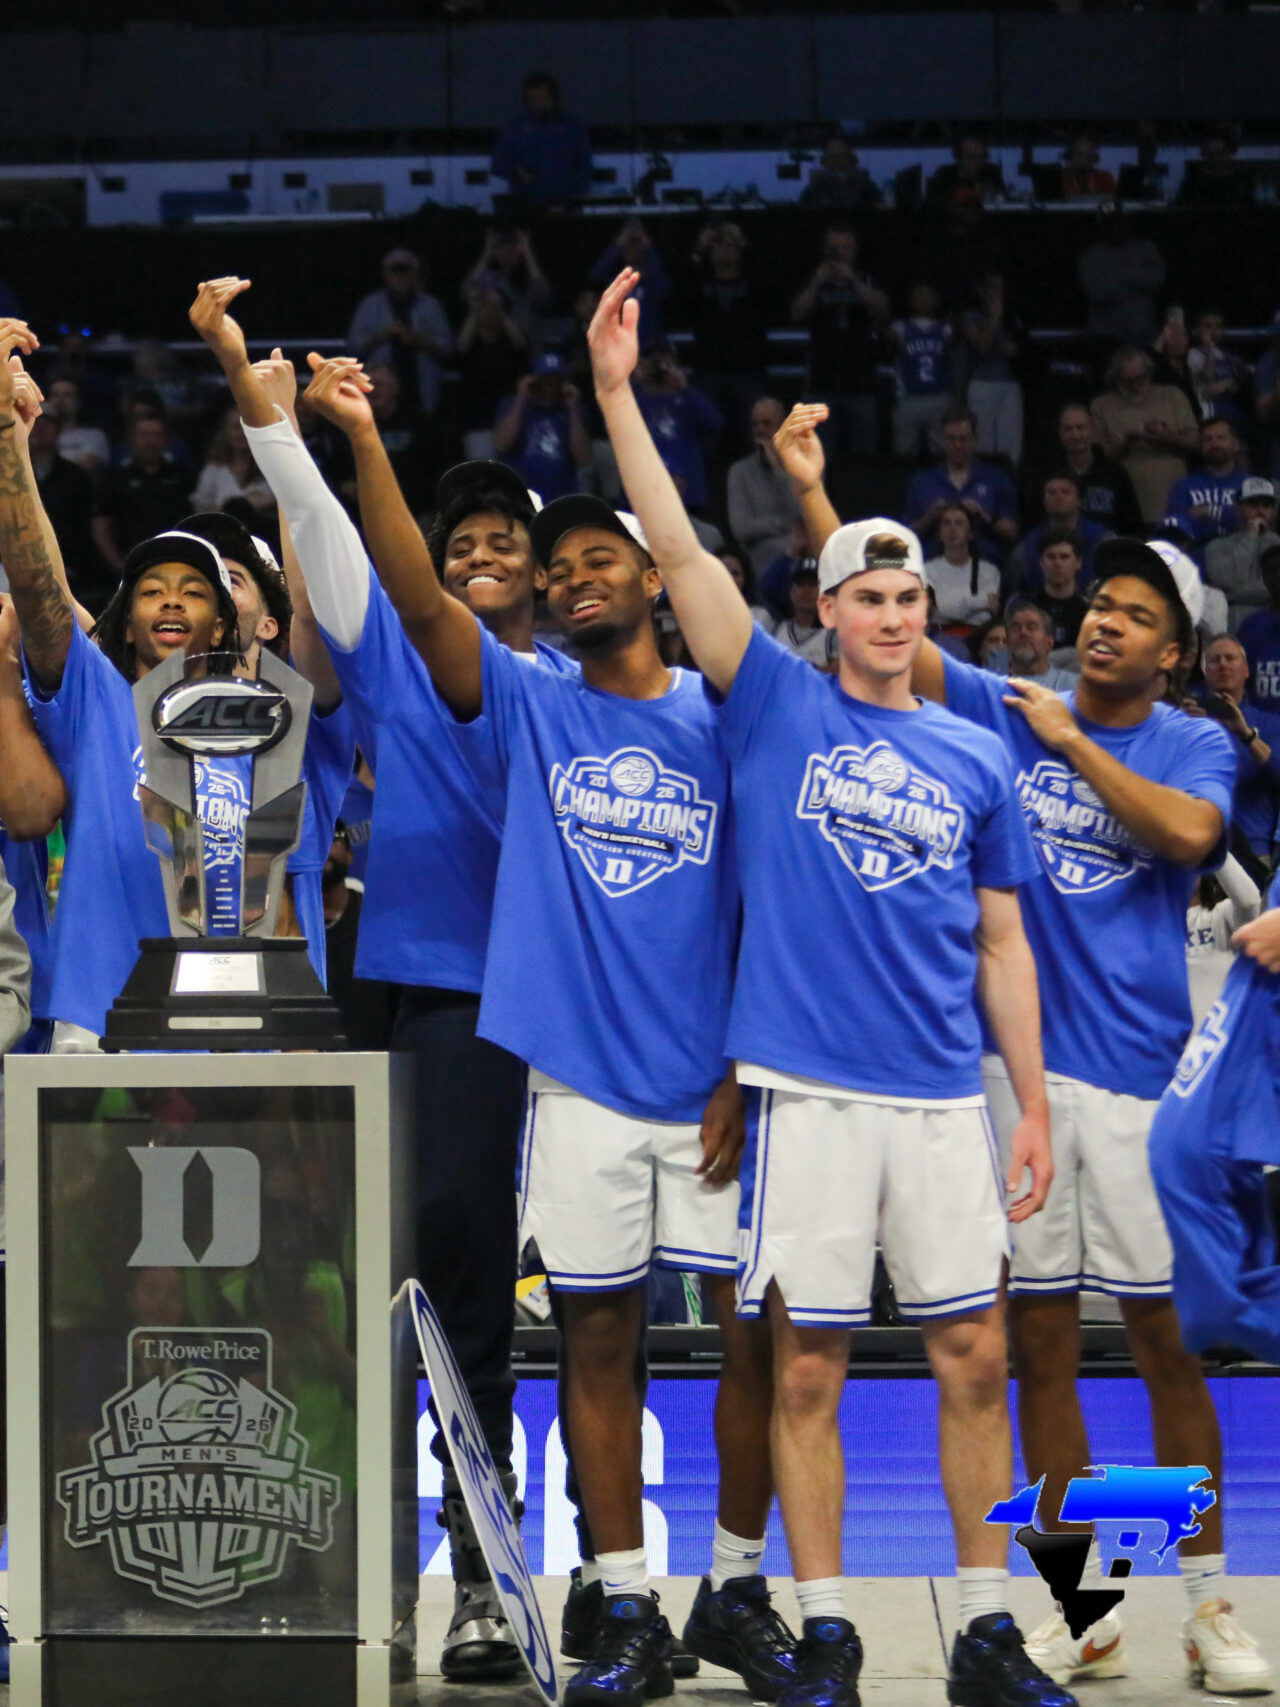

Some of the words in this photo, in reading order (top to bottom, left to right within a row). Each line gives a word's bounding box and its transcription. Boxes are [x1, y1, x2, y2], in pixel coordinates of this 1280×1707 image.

[1189, 489, 1236, 505] DUK
[174, 696, 279, 728] ACC
[589, 774, 608, 788] 20
[1049, 780, 1069, 795] 20
[655, 786, 676, 799] 26
[554, 776, 708, 851] CHAMPIONS
[807, 766, 958, 856] CHAMPIONS
[126, 1146, 260, 1267] D
[167, 1400, 239, 1418] ACC
[129, 1418, 152, 1430] 20
[246, 1419, 269, 1431] 26
[162, 1448, 237, 1462] MEN'S
[67, 1473, 331, 1532] TOURNAMENT
